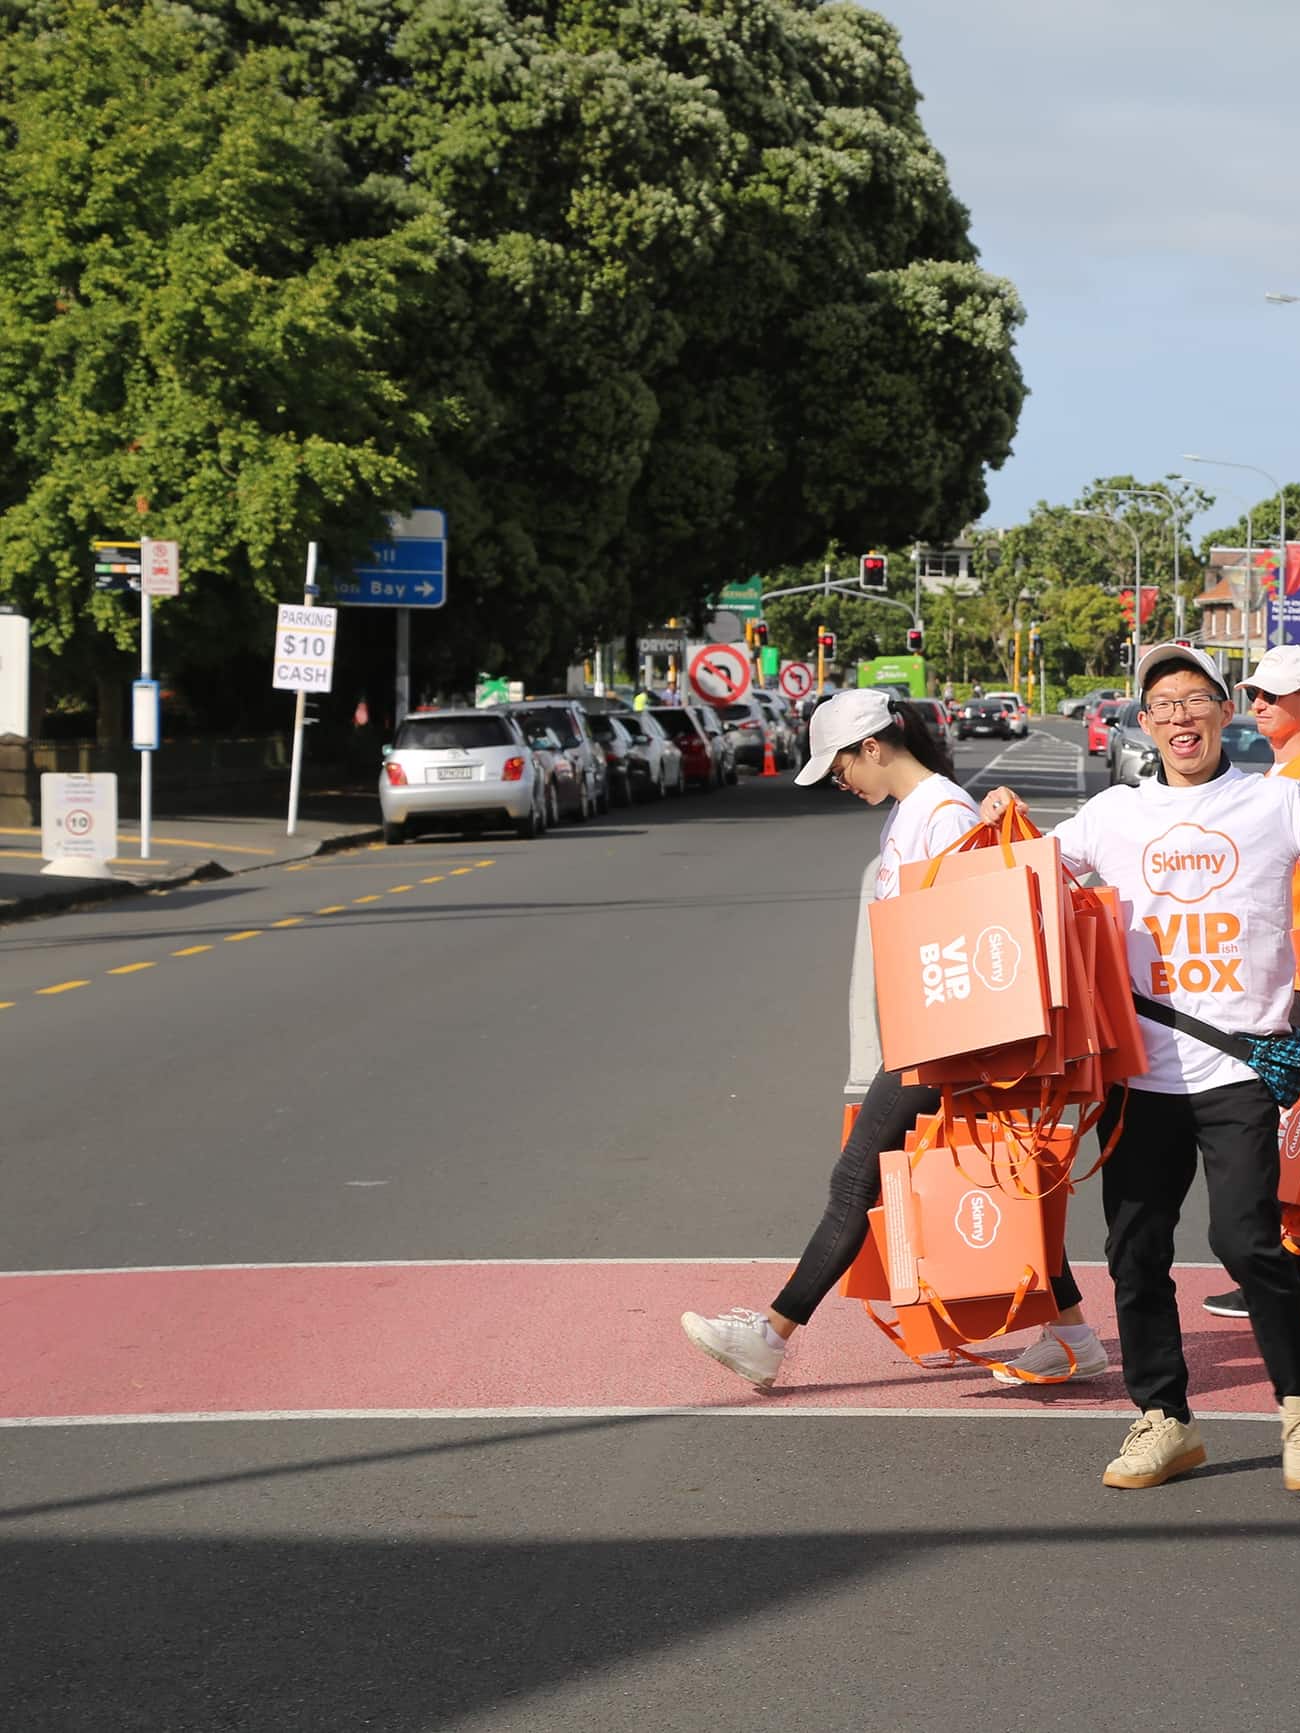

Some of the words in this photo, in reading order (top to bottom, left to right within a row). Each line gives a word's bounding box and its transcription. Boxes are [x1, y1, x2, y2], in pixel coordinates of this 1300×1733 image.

[370, 581, 405, 598] Bay
[281, 610, 332, 628] PARKING
[283, 634, 326, 657] $10
[277, 665, 327, 684] CASH
[1151, 850, 1226, 875] Skinny
[1142, 912, 1241, 955] VIP
[1221, 943, 1239, 954] ish
[919, 943, 945, 1008] BOX
[942, 935, 972, 1001] VIP
[988, 933, 1004, 982] Skinny
[1150, 958, 1245, 995] BOX
[970, 1196, 985, 1241] Skinny
